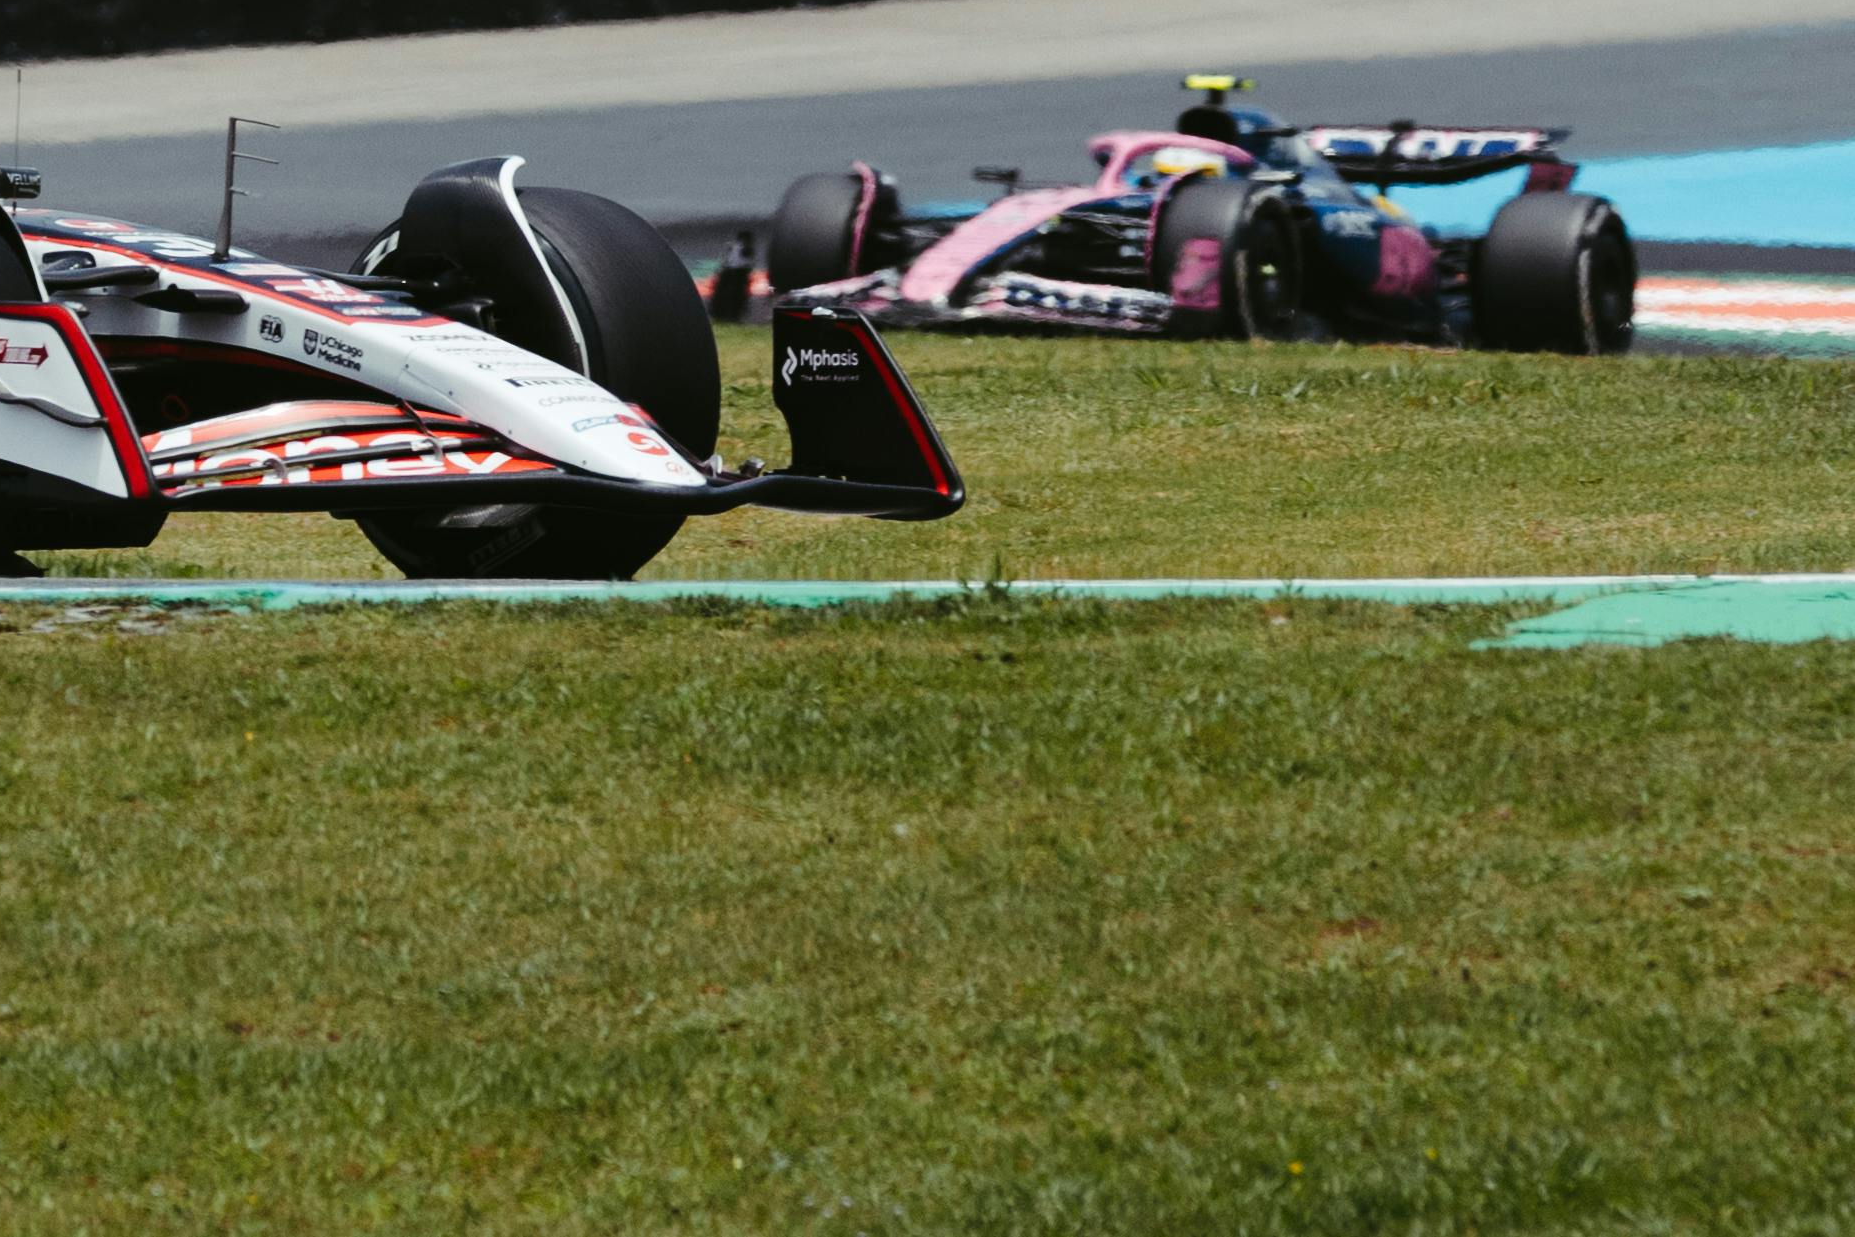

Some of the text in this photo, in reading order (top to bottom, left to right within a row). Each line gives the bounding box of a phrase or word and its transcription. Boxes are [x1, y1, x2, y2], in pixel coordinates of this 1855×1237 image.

[259, 317, 283, 338] FIA
[320, 334, 363, 358] UChicago
[318, 348, 362, 372] Medicine
[800, 349, 859, 371] Mphasis
